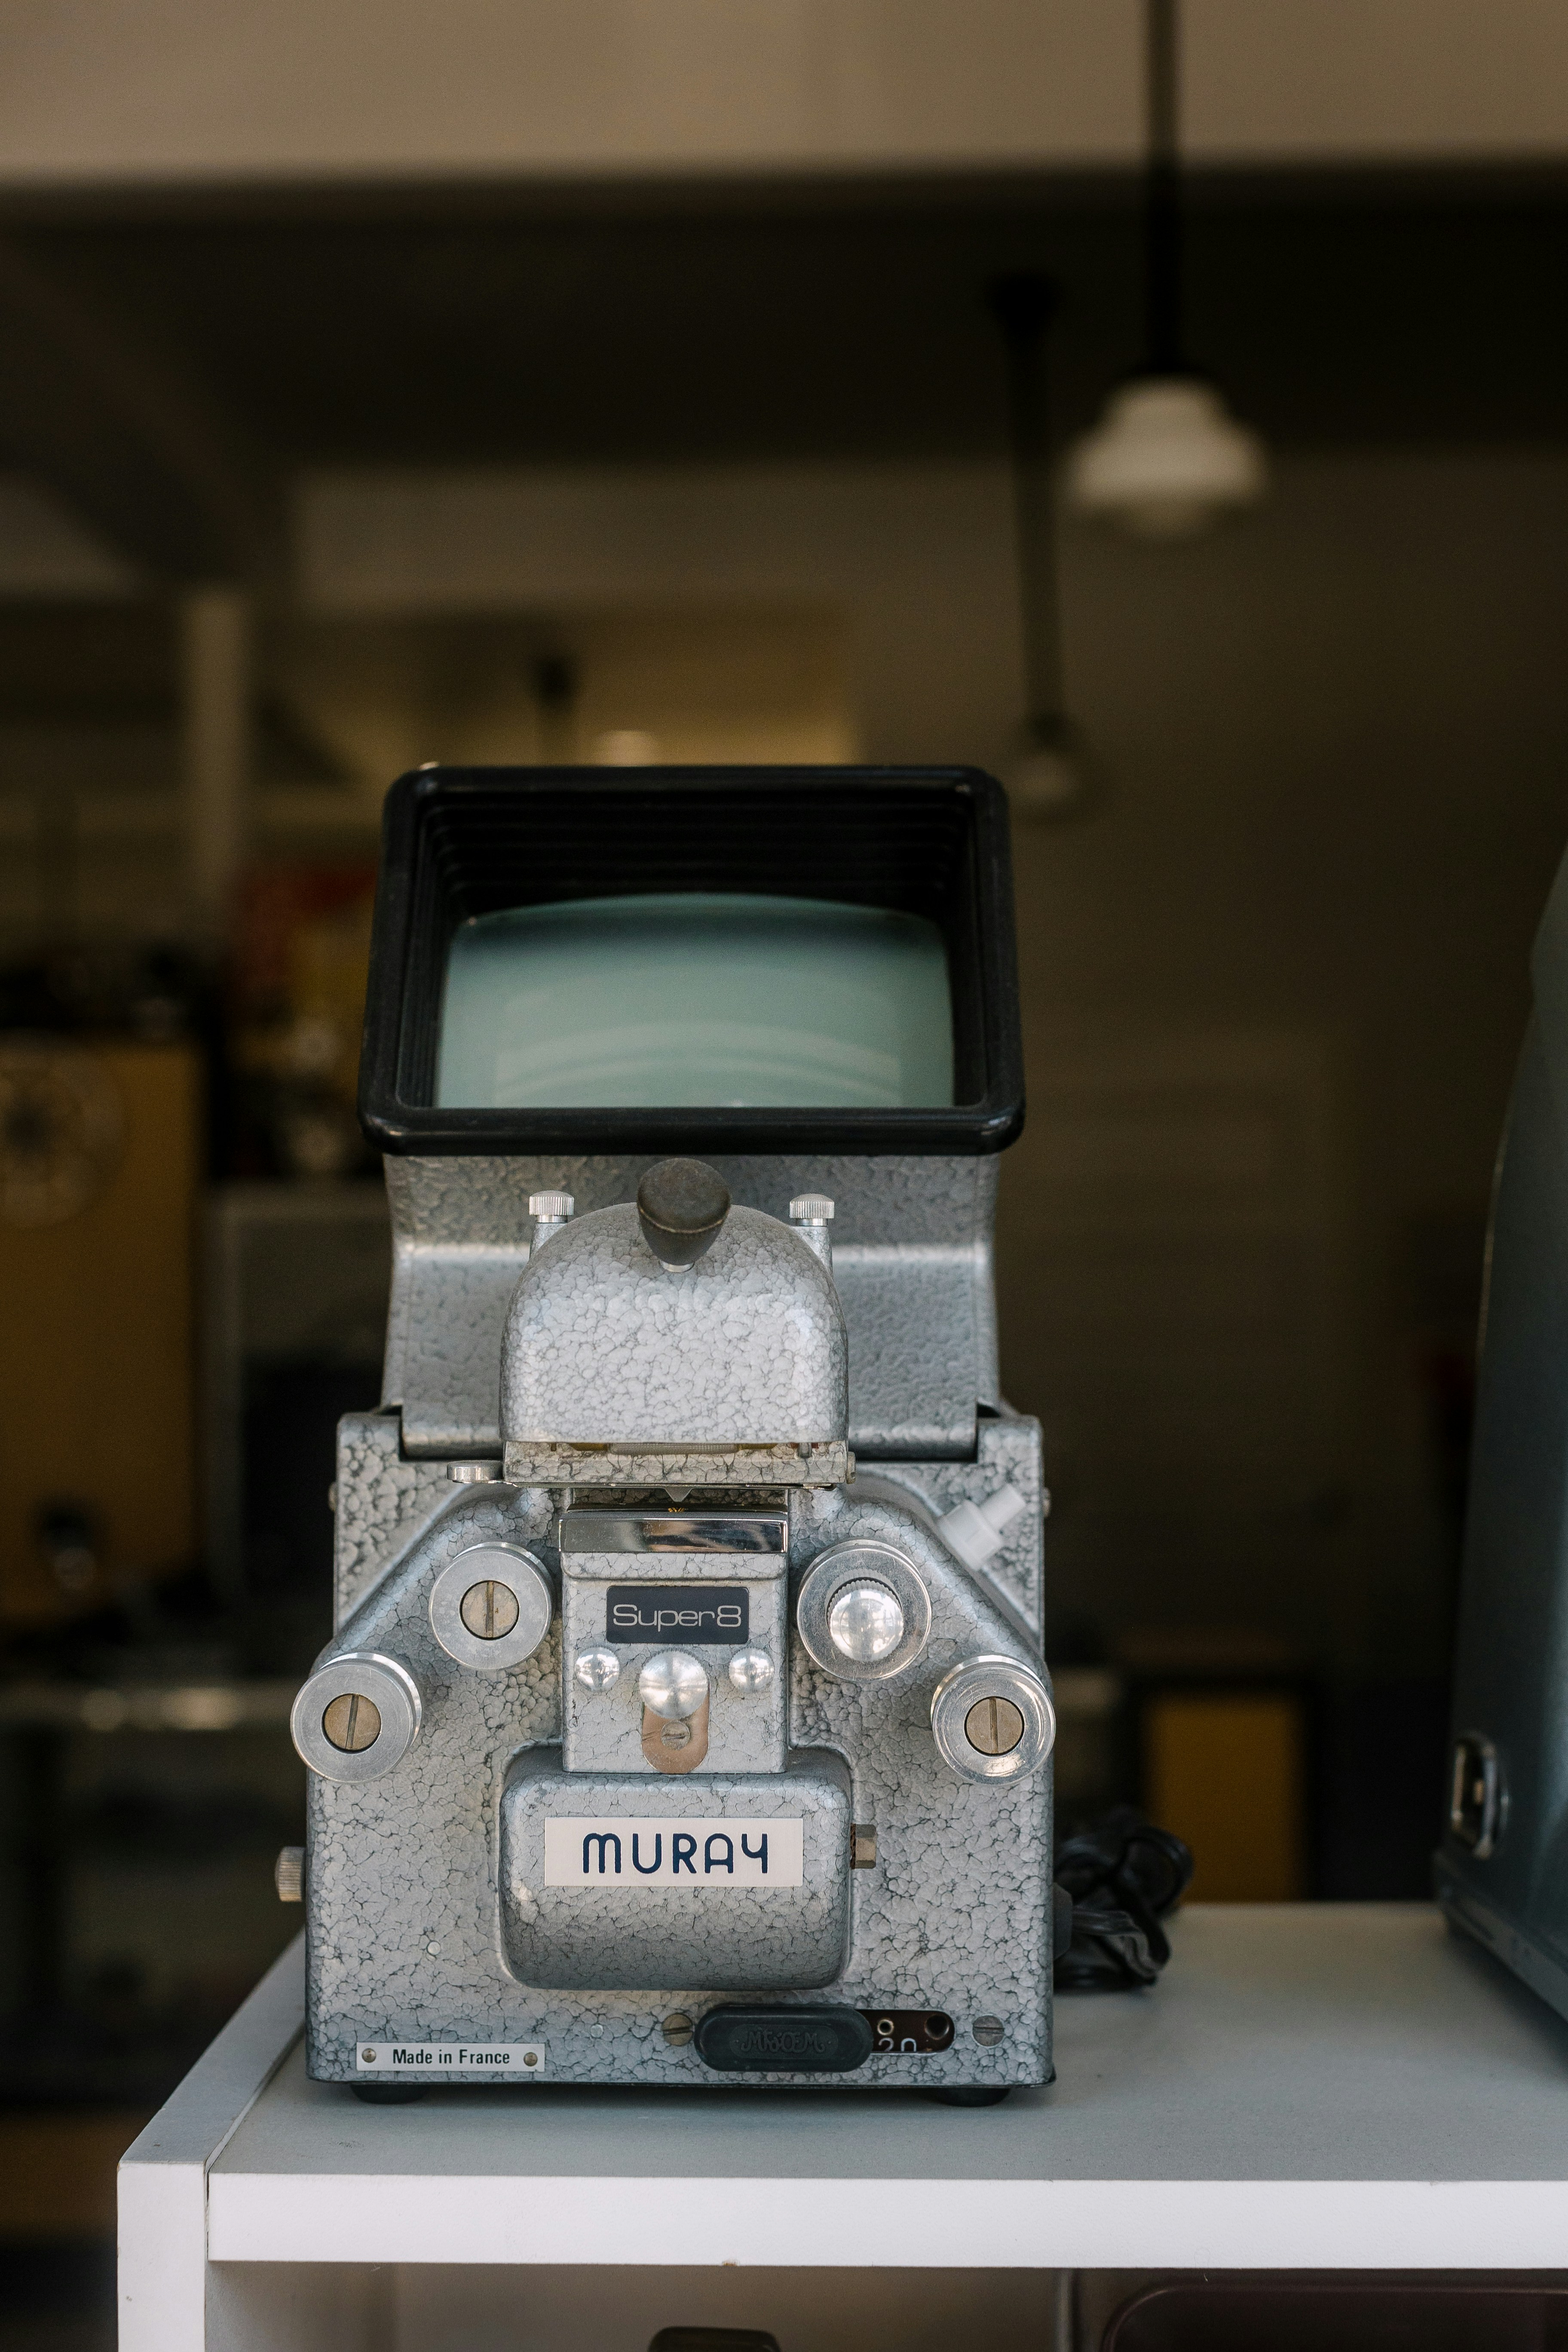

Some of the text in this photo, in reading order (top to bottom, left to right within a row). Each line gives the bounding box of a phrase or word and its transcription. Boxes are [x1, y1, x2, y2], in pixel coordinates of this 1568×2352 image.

[613, 1604, 741, 1632] Super8
[583, 1833, 768, 1874] MURAY
[393, 2049, 510, 2064] Made in France
